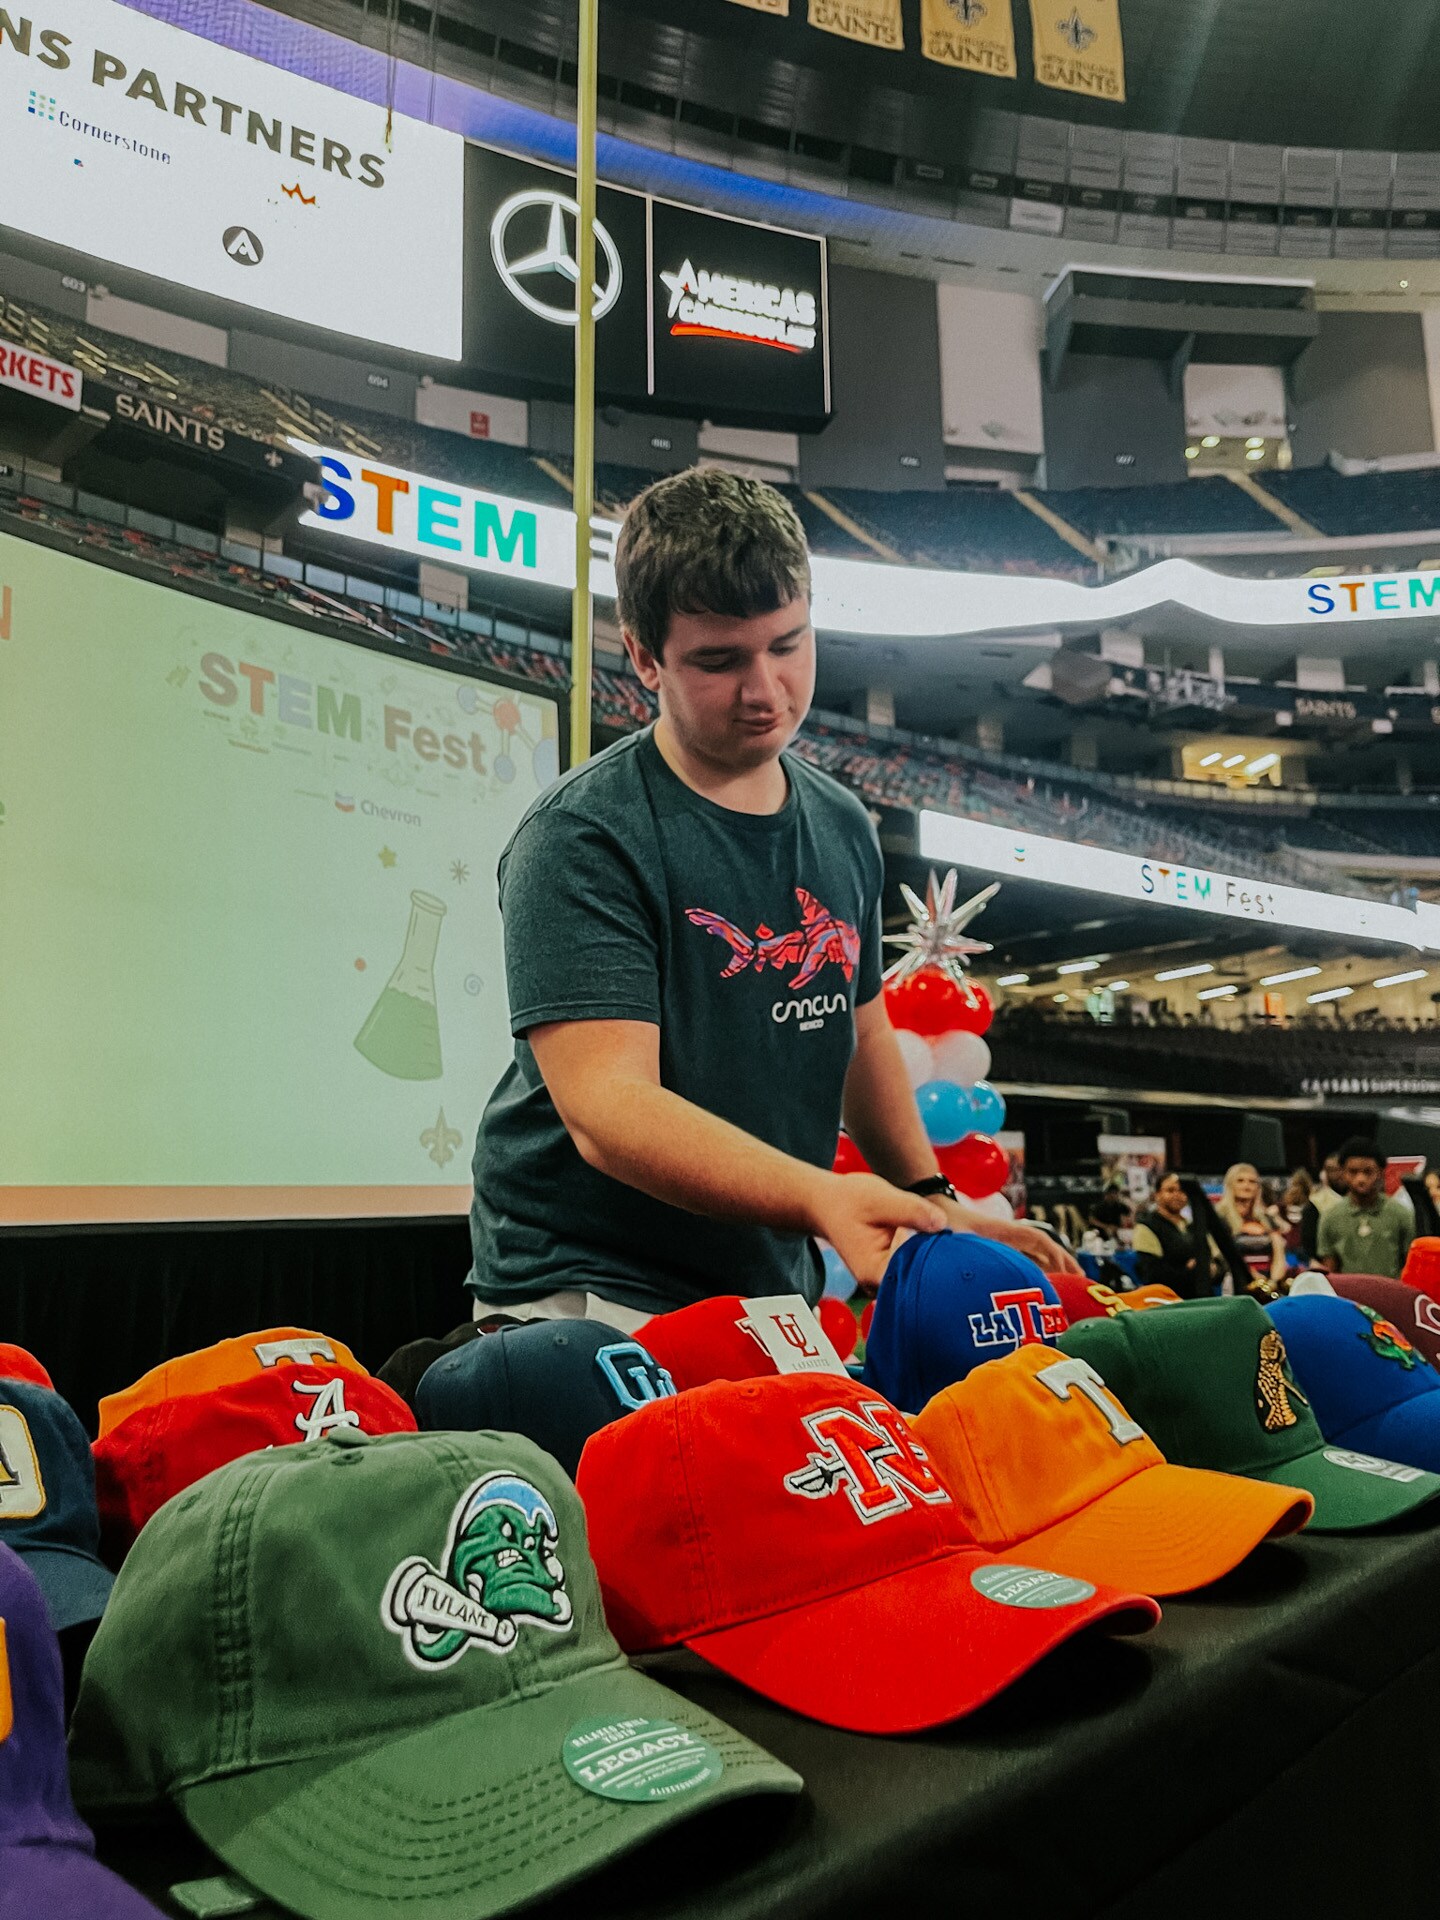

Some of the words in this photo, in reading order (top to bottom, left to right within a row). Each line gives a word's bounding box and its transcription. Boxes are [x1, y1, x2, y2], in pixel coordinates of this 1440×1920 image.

[59, 110, 171, 165] Cornerstone
[92, 48, 386, 189] PARTNERS
[115, 394, 226, 452] SAINTS
[318, 456, 537, 569] STEM
[1307, 577, 1440, 615] STEM
[199, 651, 363, 743] STEM
[384, 704, 488, 777] Fest
[361, 799, 422, 827] Chevron
[1141, 864, 1212, 901] STEM
[1225, 882, 1275, 915] Fest
[1036, 1357, 1144, 1447] T
[578, 1732, 695, 1783] LEGACY
